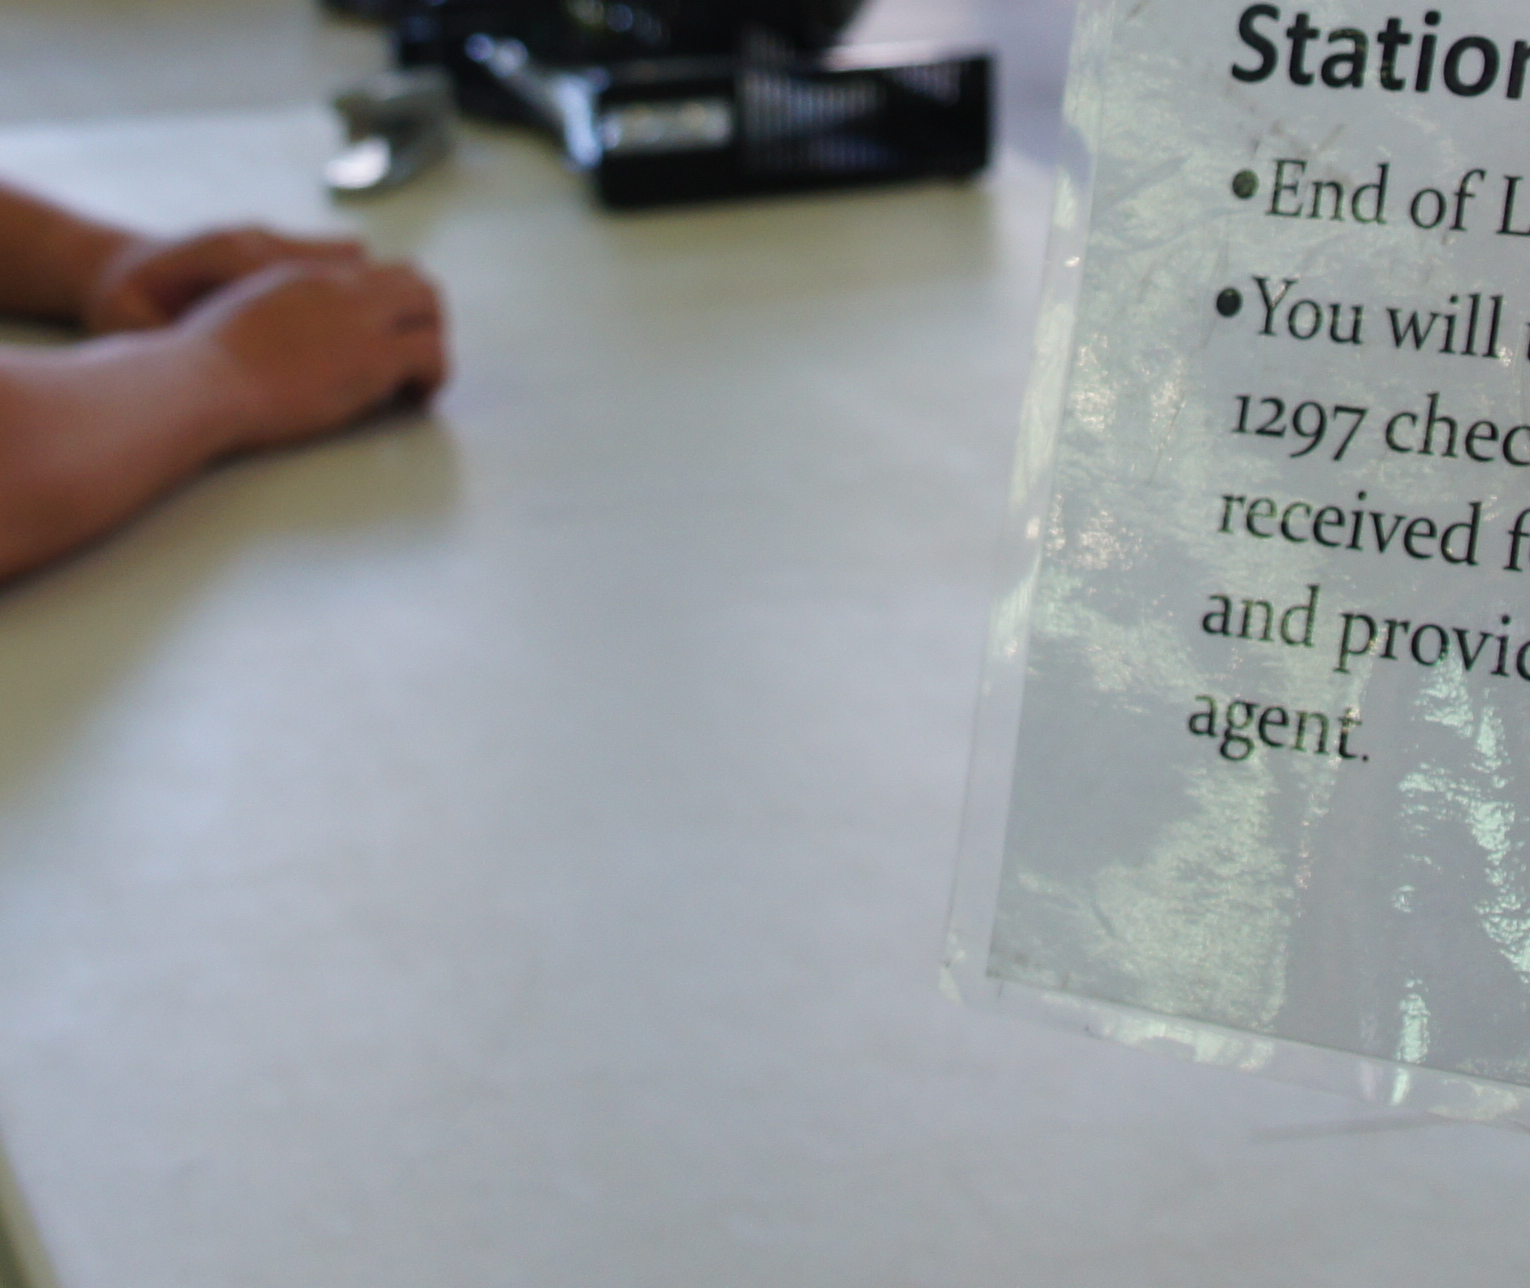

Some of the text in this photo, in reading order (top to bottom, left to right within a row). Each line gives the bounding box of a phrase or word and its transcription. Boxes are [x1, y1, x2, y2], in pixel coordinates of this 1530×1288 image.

[1265, 158, 1391, 225] End
[1409, 168, 1487, 232] of
[1252, 275, 1364, 346] You
[1386, 292, 1505, 360] will
[1230, 392, 1370, 462] 1297
[1216, 489, 1483, 567] received
[1201, 583, 1321, 648] and
[1187, 693, 1370, 763] agent.
